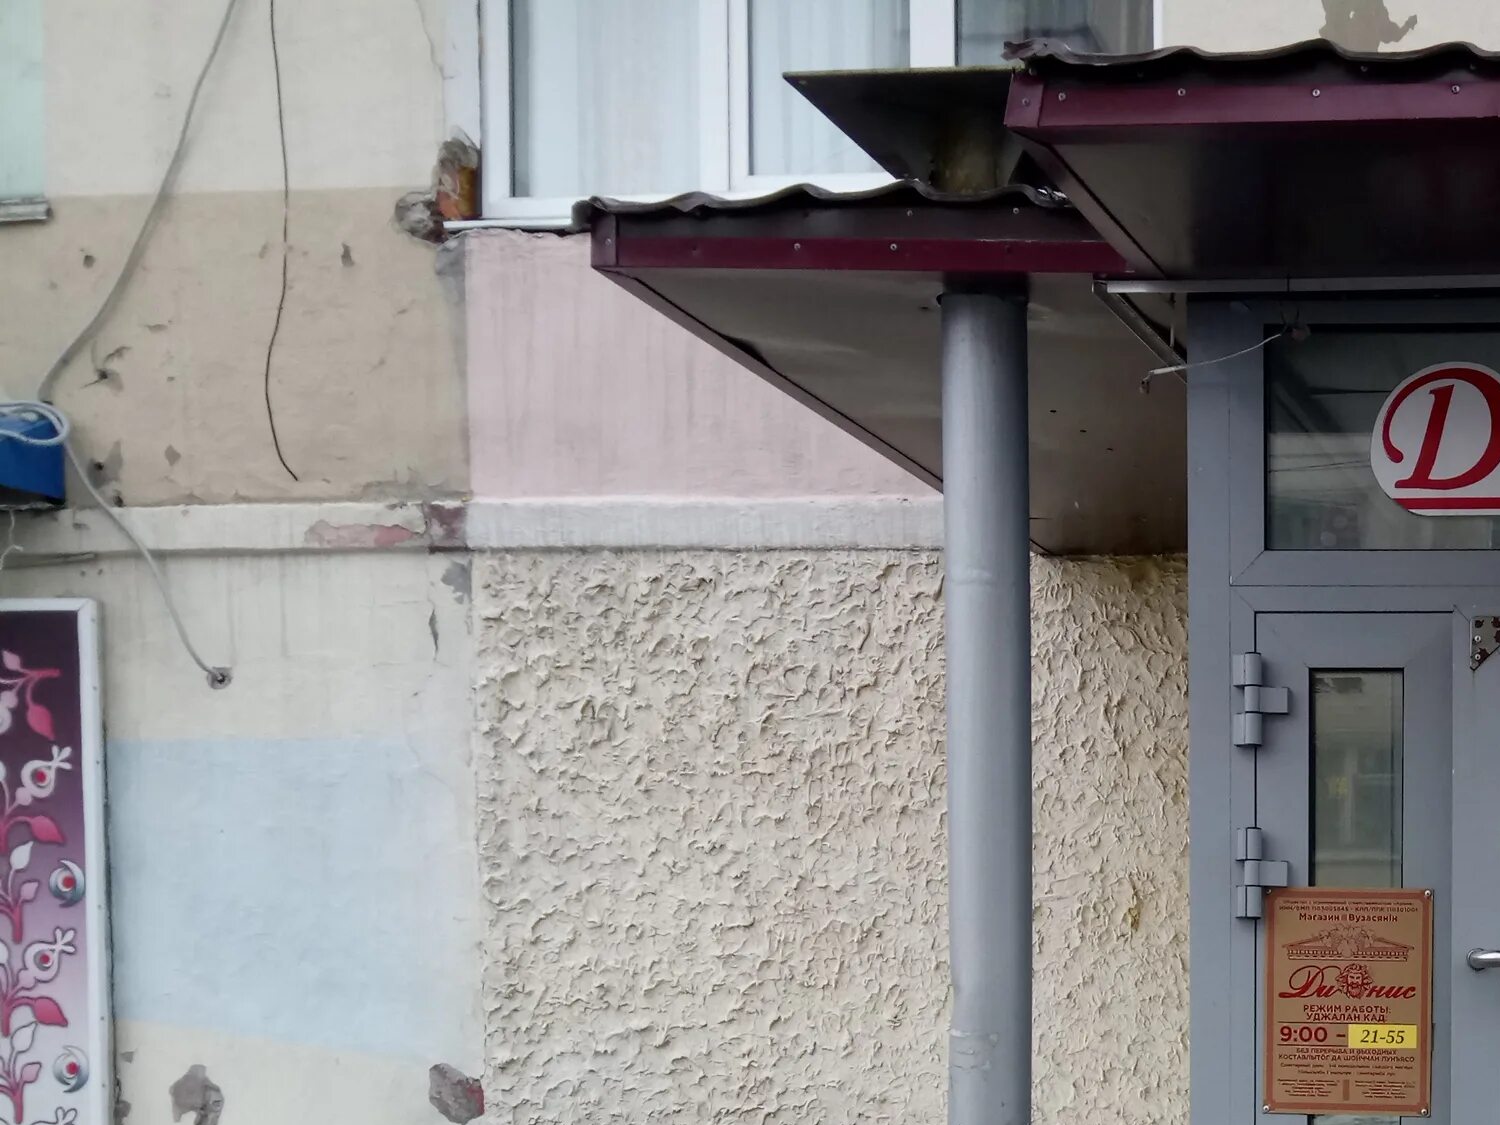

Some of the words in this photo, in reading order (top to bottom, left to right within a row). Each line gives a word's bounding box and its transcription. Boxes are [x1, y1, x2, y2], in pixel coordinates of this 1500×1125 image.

[1299, 912, 1340, 921] Магазин
[1278, 965, 1417, 999] Динис
[1303, 1004, 1341, 1012] РЕЖИМ
[1345, 1005, 1391, 1014] РАБОТЫ:
[1306, 1012, 1360, 1021] УДЖАЛАН
[1280, 1026, 1328, 1043] 9:00
[1360, 1029, 1405, 1044] 21-55
